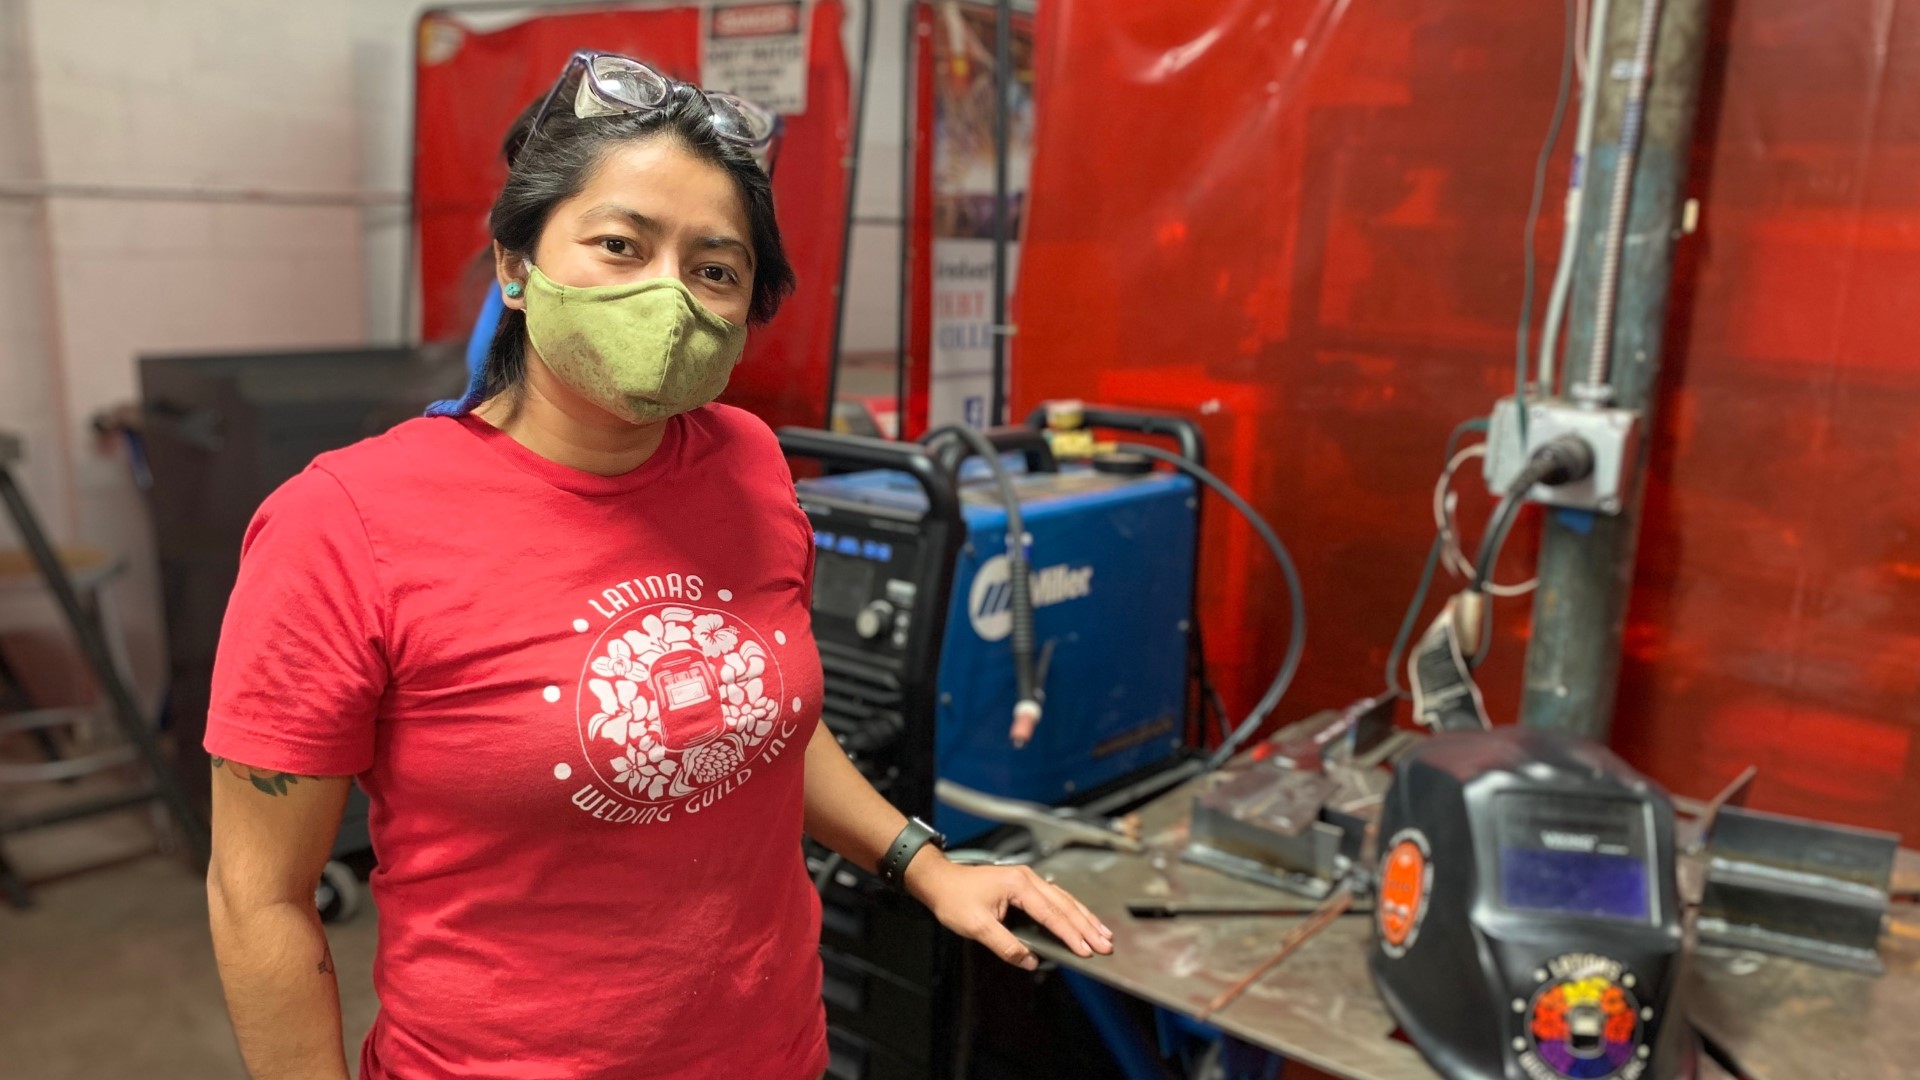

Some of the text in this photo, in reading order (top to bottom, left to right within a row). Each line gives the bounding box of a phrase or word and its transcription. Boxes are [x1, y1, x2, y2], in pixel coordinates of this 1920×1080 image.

[588, 573, 704, 619] LATINAS
[571, 720, 798, 825] WELDING GUILD INC
